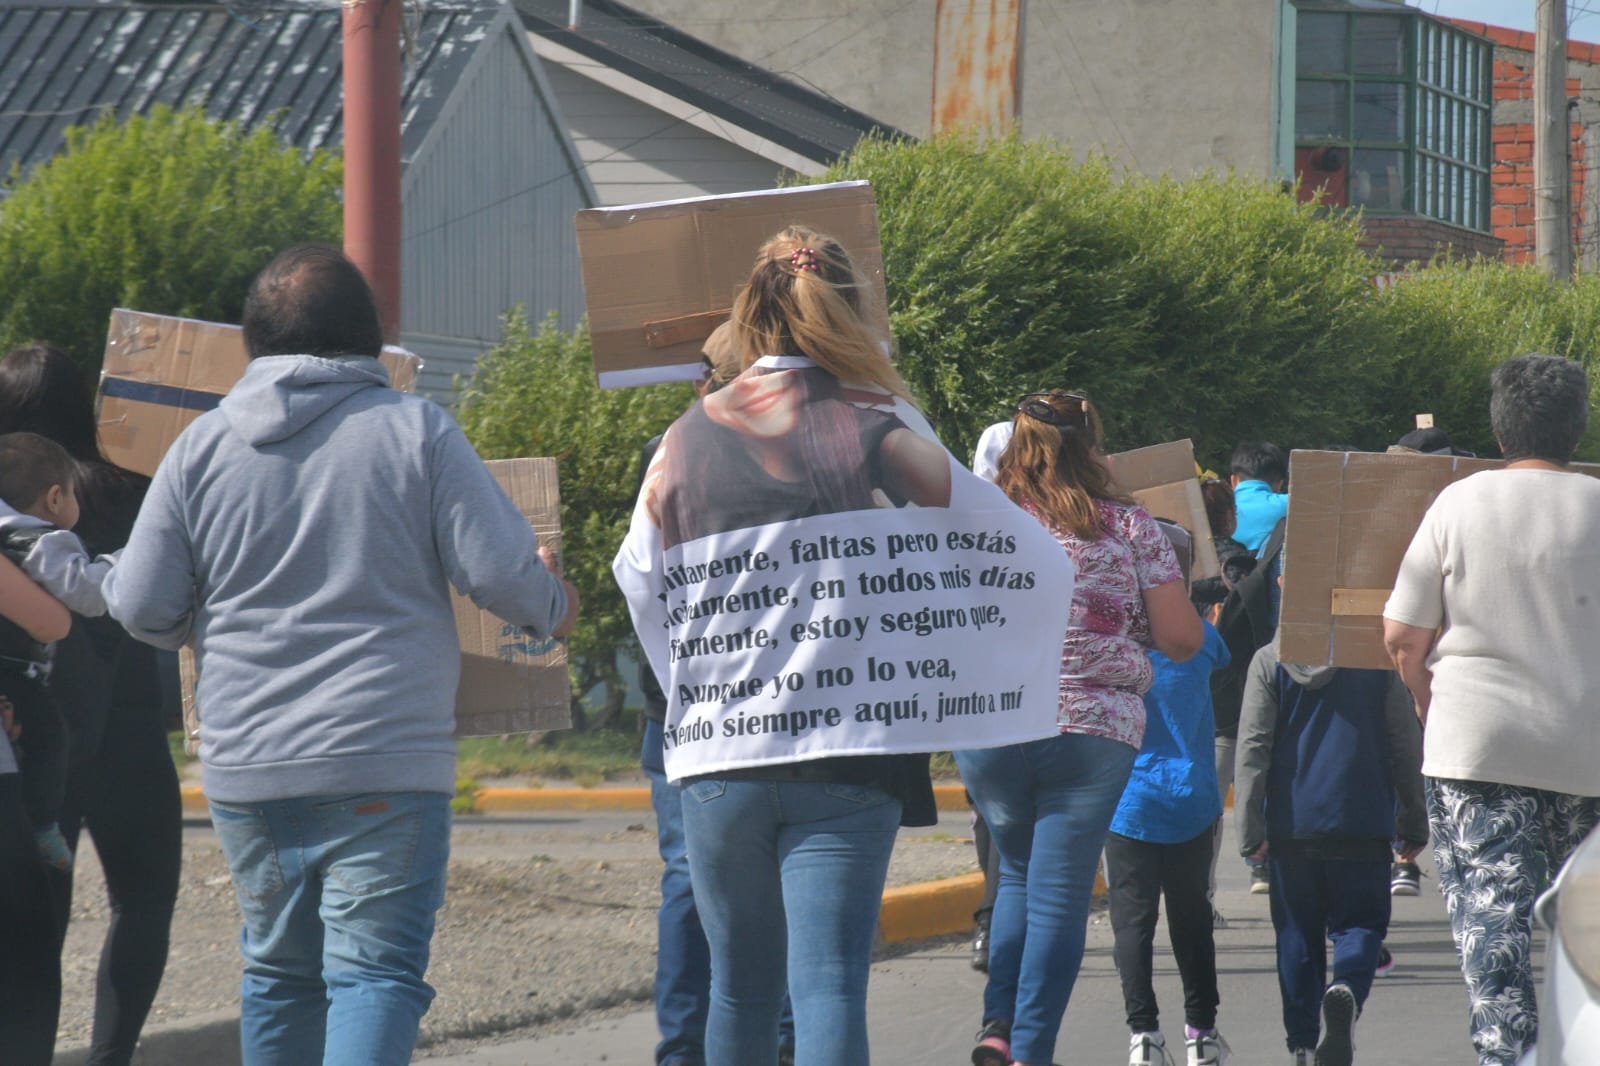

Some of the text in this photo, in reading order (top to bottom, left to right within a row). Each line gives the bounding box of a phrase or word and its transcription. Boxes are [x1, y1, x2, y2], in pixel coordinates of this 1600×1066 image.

[789, 536, 876, 565] faltas
[887, 531, 939, 560] pero
[946, 530, 1017, 554] estás
[810, 578, 846, 601] en
[858, 567, 936, 596] todos
[939, 564, 971, 590] mis
[978, 565, 1036, 591] días
[790, 614, 870, 642] estoy
[880, 606, 967, 636] seguro
[970, 604, 1007, 632] que,
[678, 656, 957, 706] Aunque yo no lo vea,
[722, 706, 842, 737] siempre
[855, 693, 928, 727] aquí,
[936, 692, 985, 723] junto
[988, 694, 996, 713] a
[1000, 685, 1025, 711] mí
